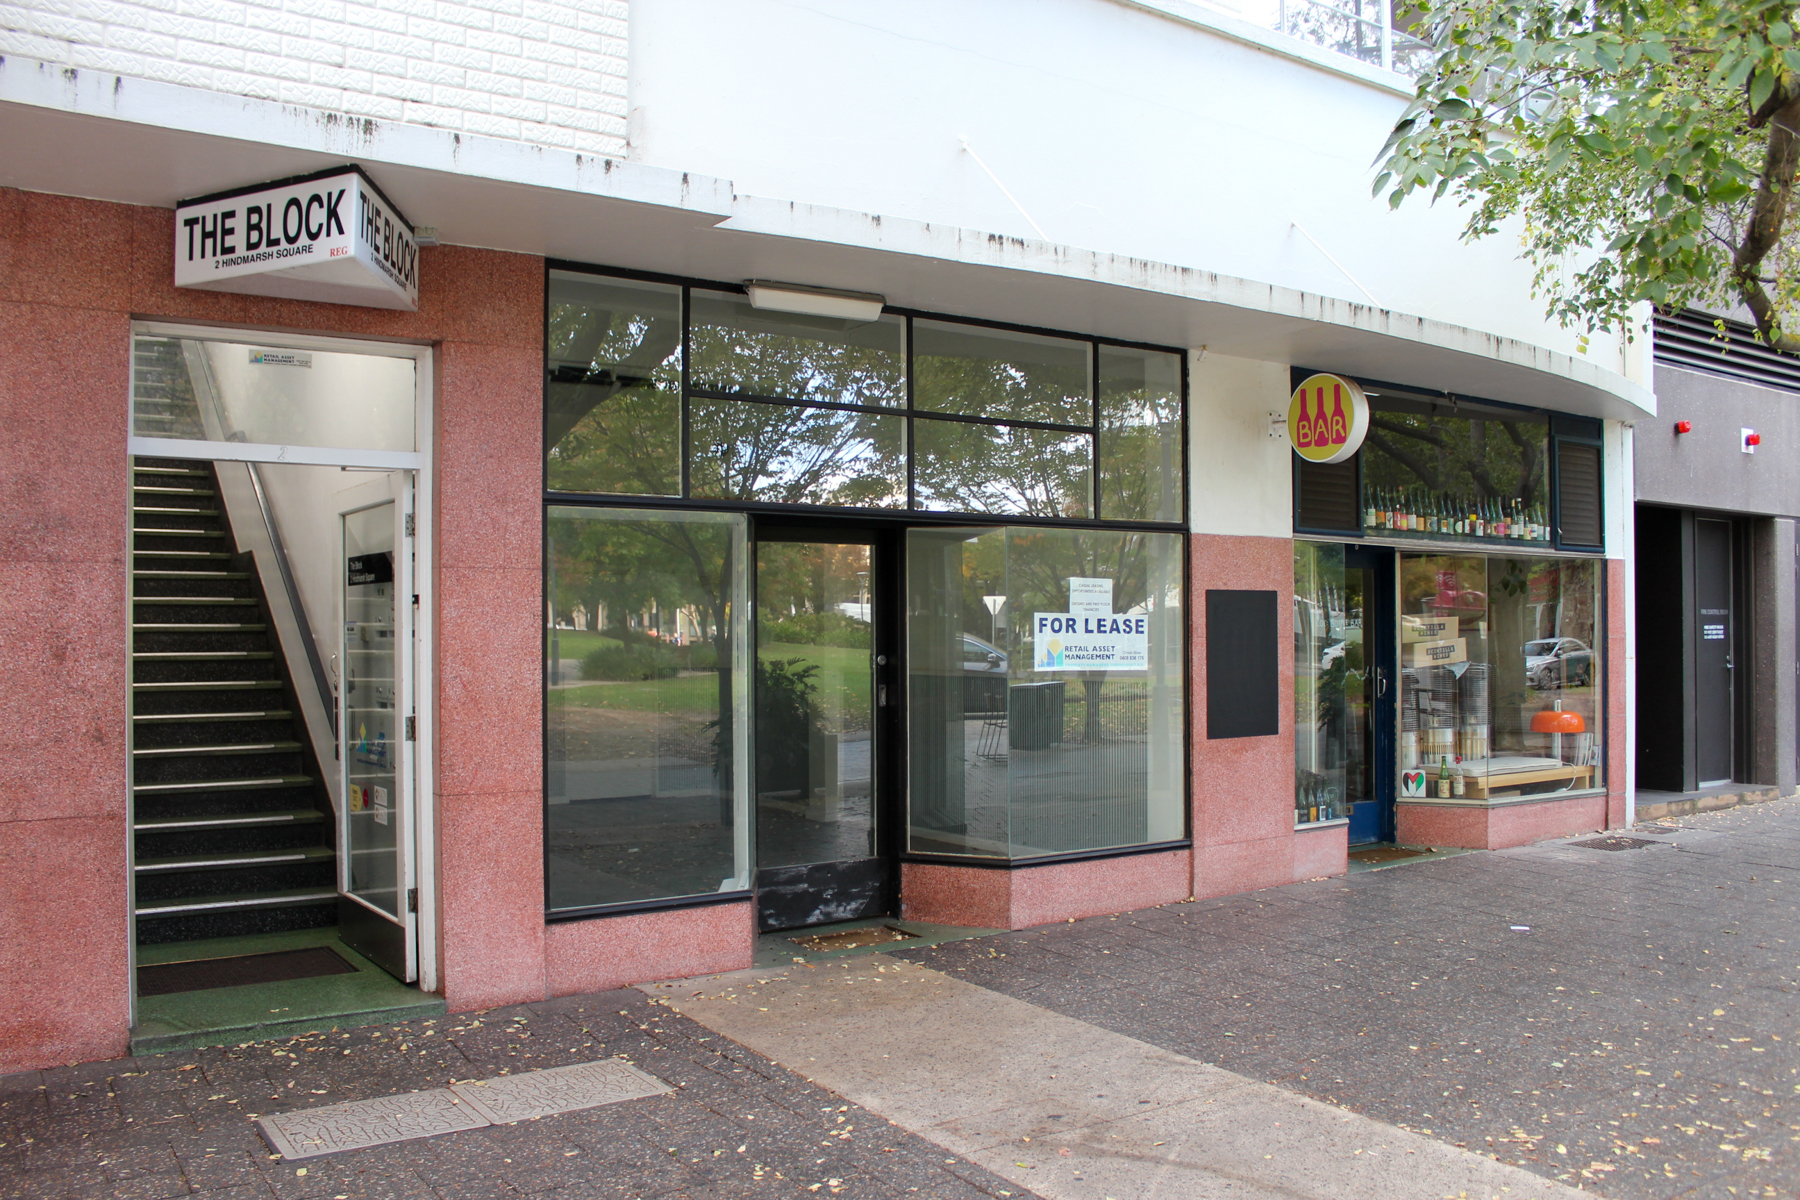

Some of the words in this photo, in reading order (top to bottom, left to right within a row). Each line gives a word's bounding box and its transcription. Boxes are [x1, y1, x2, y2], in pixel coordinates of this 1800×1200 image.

[184, 210, 236, 261] THE
[245, 189, 346, 252] BLOCK
[329, 246, 348, 257] REG
[360, 190, 381, 255] THE
[383, 216, 416, 289] BLOCK
[214, 260, 220, 269] 2
[221, 251, 274, 268] HINDMARSH
[276, 244, 314, 260] SQUARE
[1299, 416, 1346, 443] BAR
[1038, 617, 1077, 634] FOR
[1084, 618, 1145, 634] LEASE
